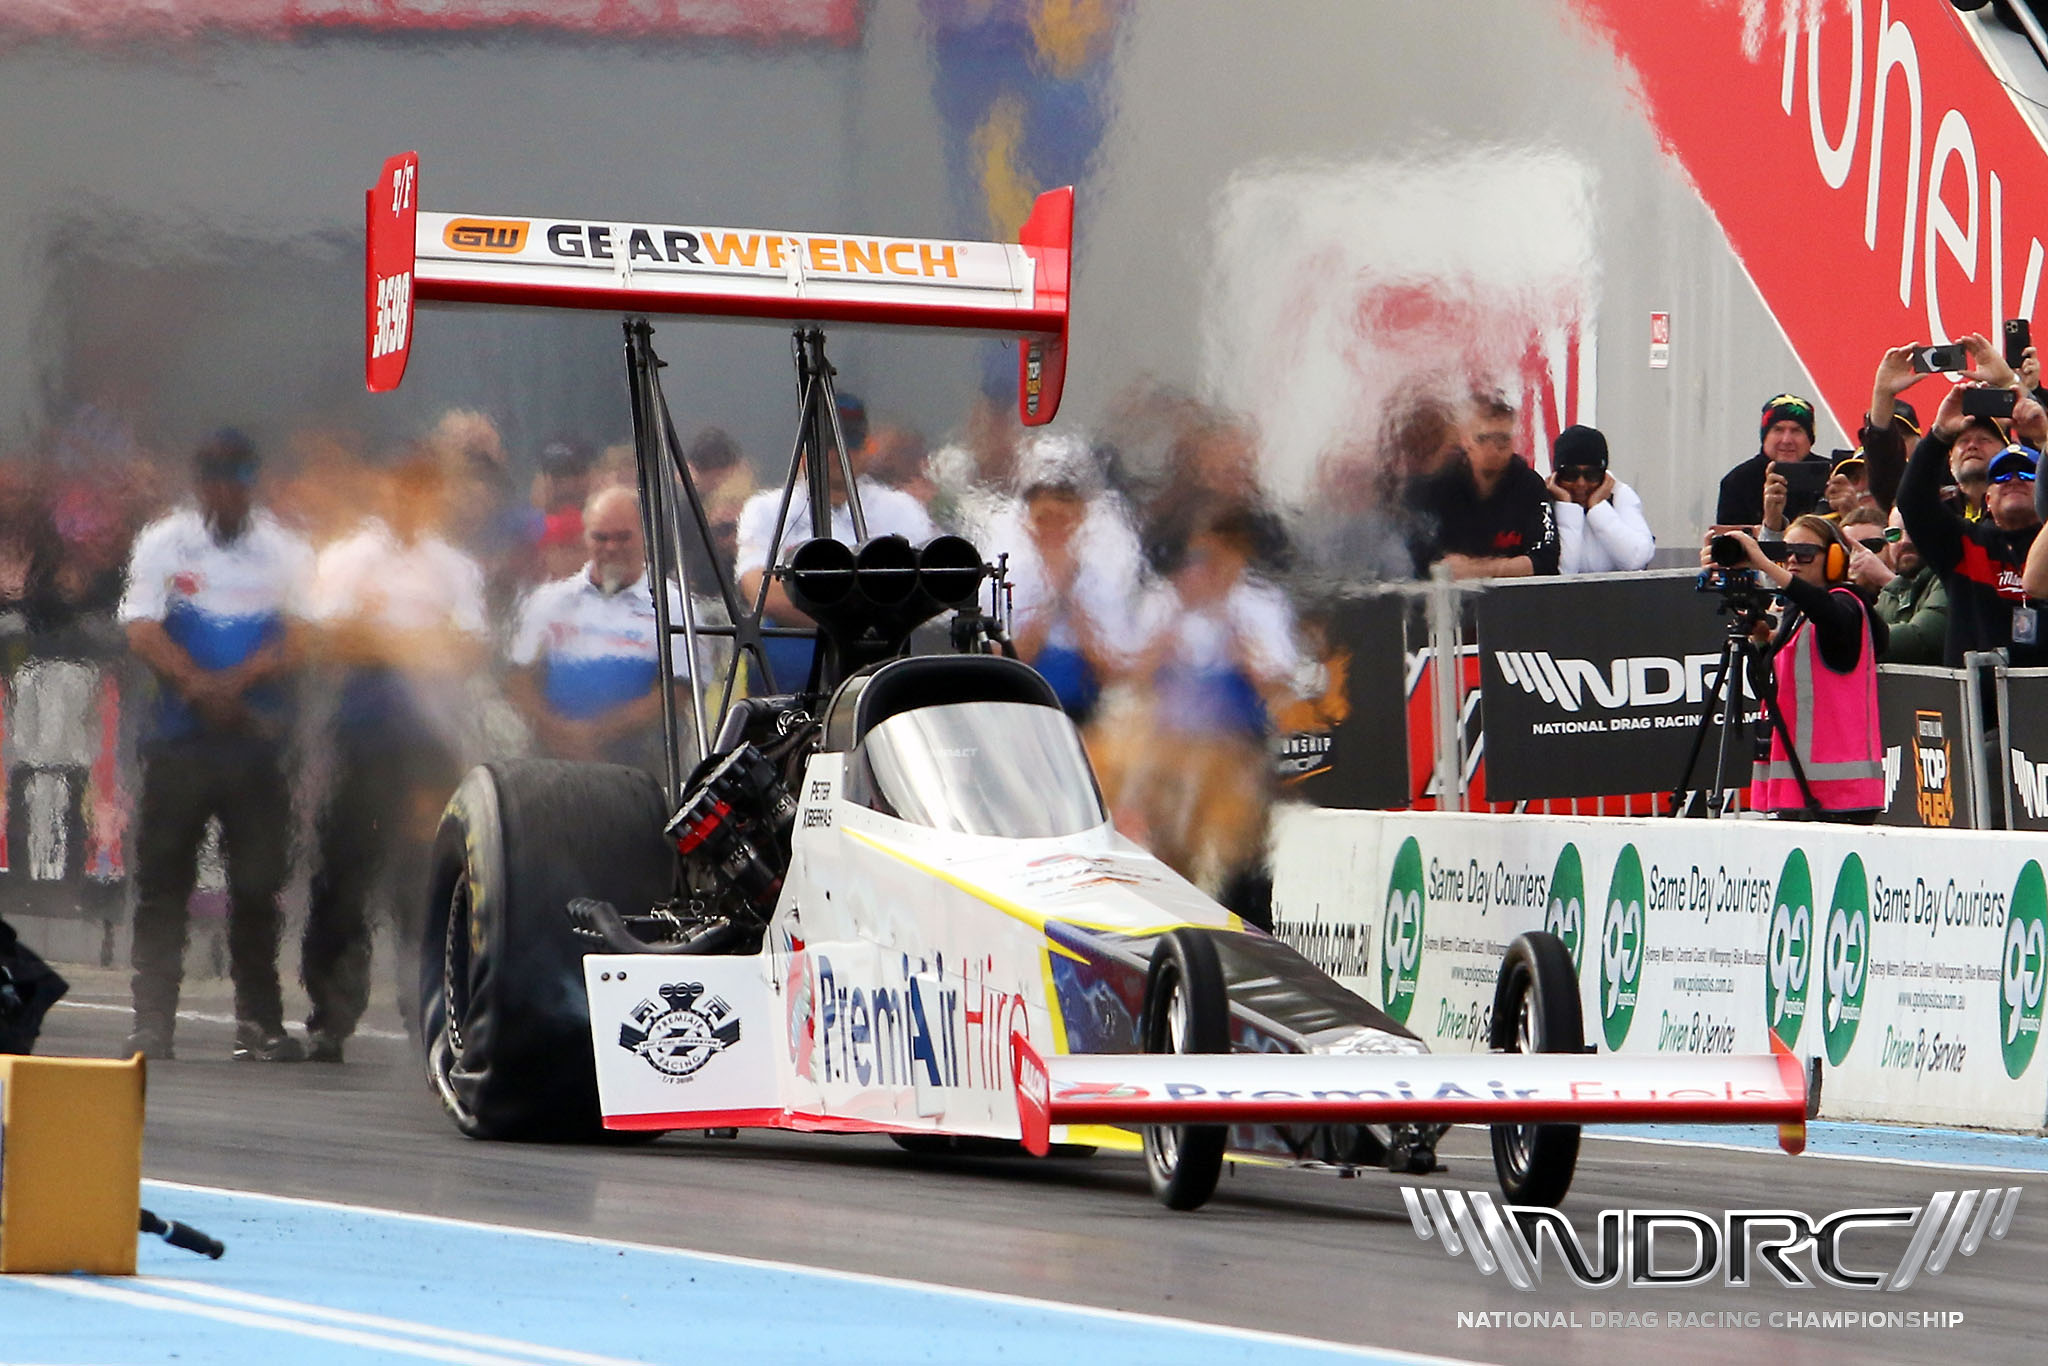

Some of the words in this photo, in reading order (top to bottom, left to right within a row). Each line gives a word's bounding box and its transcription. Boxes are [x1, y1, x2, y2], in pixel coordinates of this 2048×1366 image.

[547, 224, 958, 278] GEARWRENCH
[372, 271, 410, 359] 3698
[1533, 721, 1607, 735] NATIONAL
[1611, 717, 1650, 731] DRAG
[1654, 714, 1703, 729] RACIN
[1920, 748, 1946, 789] TOP
[1428, 857, 1464, 903] Same
[1468, 858, 1493, 916] Day
[1495, 861, 1546, 908] Couriers
[1649, 864, 1686, 912] Same
[1690, 865, 1715, 924] Day
[1717, 865, 1771, 914] Couriers
[1873, 875, 1910, 922] Same
[1914, 877, 1941, 938] Day
[1945, 879, 2005, 927] Couriers
[1437, 997, 1467, 1040] Driven
[1468, 1001, 1481, 1052] By
[1658, 1009, 1689, 1051] Driven
[1881, 1024, 1915, 1068] Driven
[1915, 1027, 1929, 1082] By
[1927, 1032, 1967, 1073] Service
